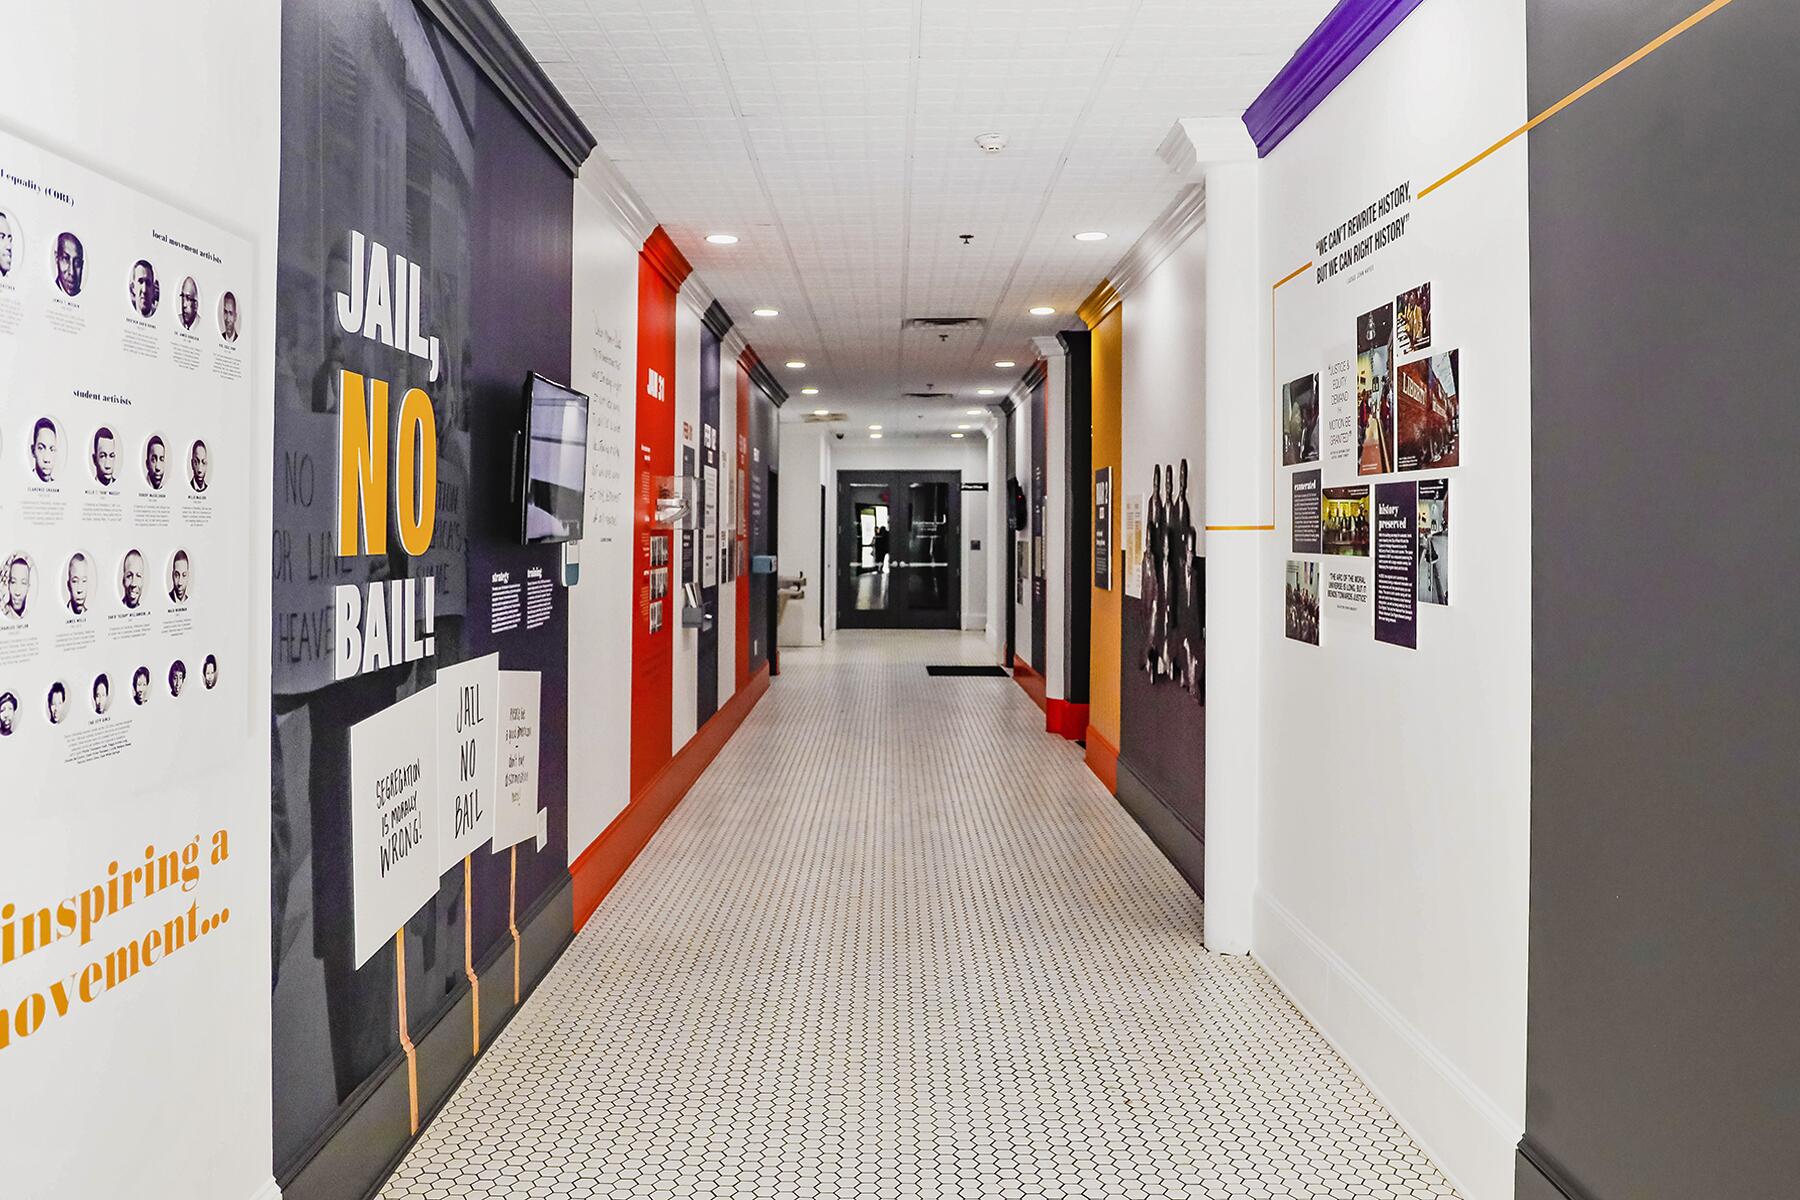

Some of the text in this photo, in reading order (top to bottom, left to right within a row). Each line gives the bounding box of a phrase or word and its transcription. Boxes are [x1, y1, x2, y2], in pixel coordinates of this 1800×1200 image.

[152, 229, 168, 242] local
[1348, 202, 1377, 238] REWRITE
[1316, 262, 1328, 285] BUT
[1329, 256, 1338, 277] WE
[1340, 248, 1352, 272] CAN
[1354, 234, 1373, 263] RIGHT
[336, 229, 440, 383] JAIL,
[73, 390, 132, 406] student activists
[286, 451, 314, 507] NO
[337, 368, 437, 558] NO
[1378, 503, 1399, 518] history
[1378, 516, 1406, 532] preserved
[279, 604, 335, 665] HEAVE
[334, 576, 436, 681] BAIL!
[456, 683, 484, 734] JAIL
[376, 758, 420, 809] SEGREGATION
[460, 738, 476, 782] NO
[381, 790, 418, 838] IS MORALLY
[455, 788, 483, 839] BAIL
[379, 811, 423, 879] WRONG!
[1, 829, 230, 967] inspiring a
